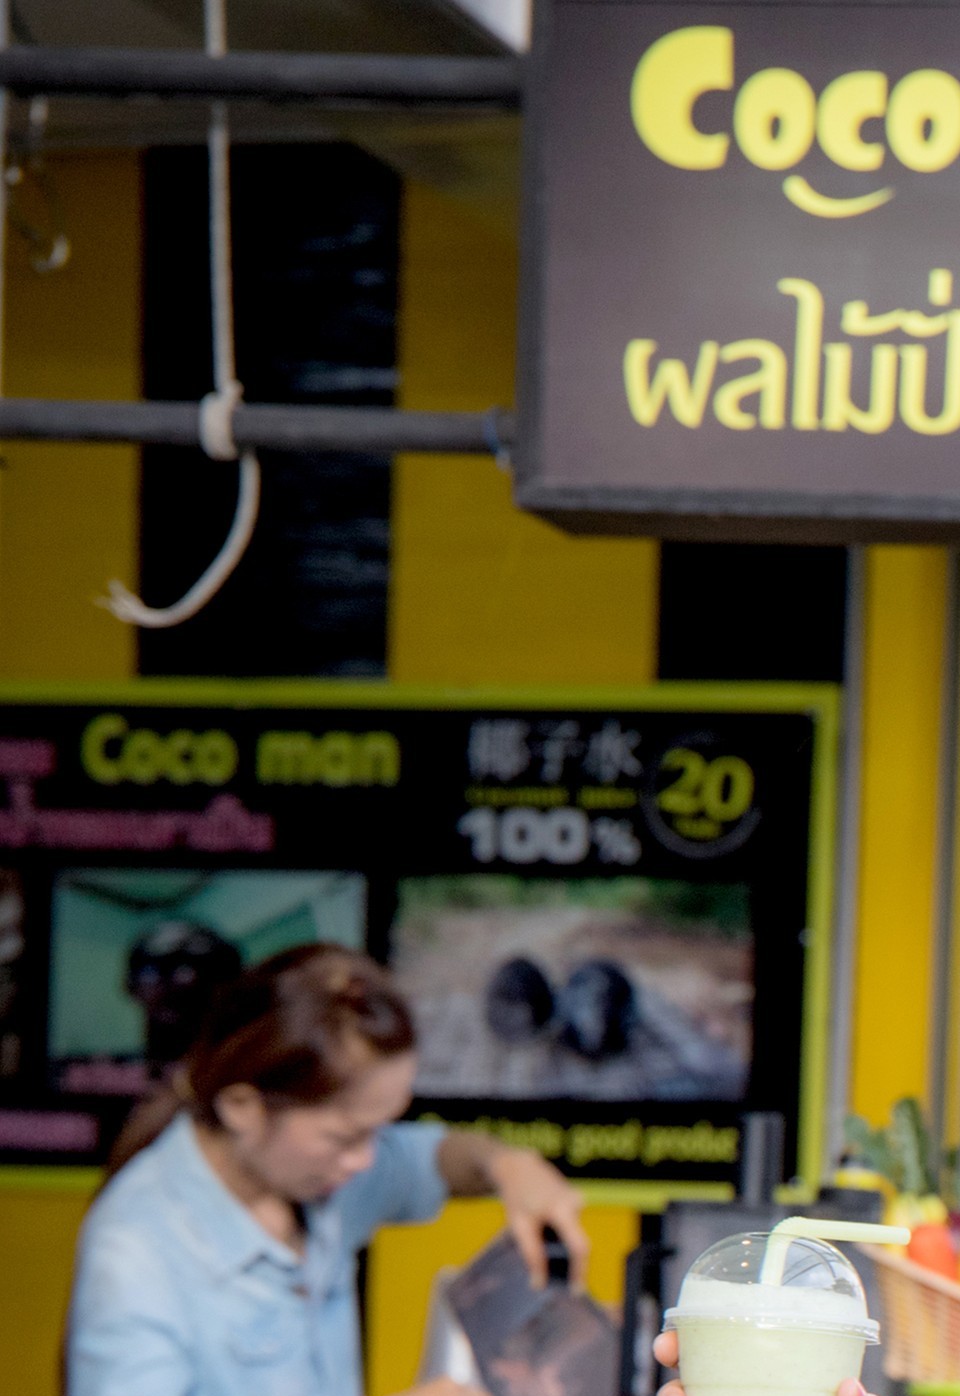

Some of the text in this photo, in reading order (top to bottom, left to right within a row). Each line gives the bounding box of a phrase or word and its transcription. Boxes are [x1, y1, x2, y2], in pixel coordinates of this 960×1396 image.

[82, 714, 237, 783] Coco
[257, 732, 399, 784] man
[658, 749, 754, 821] 20
[567, 1119, 640, 1166] good
